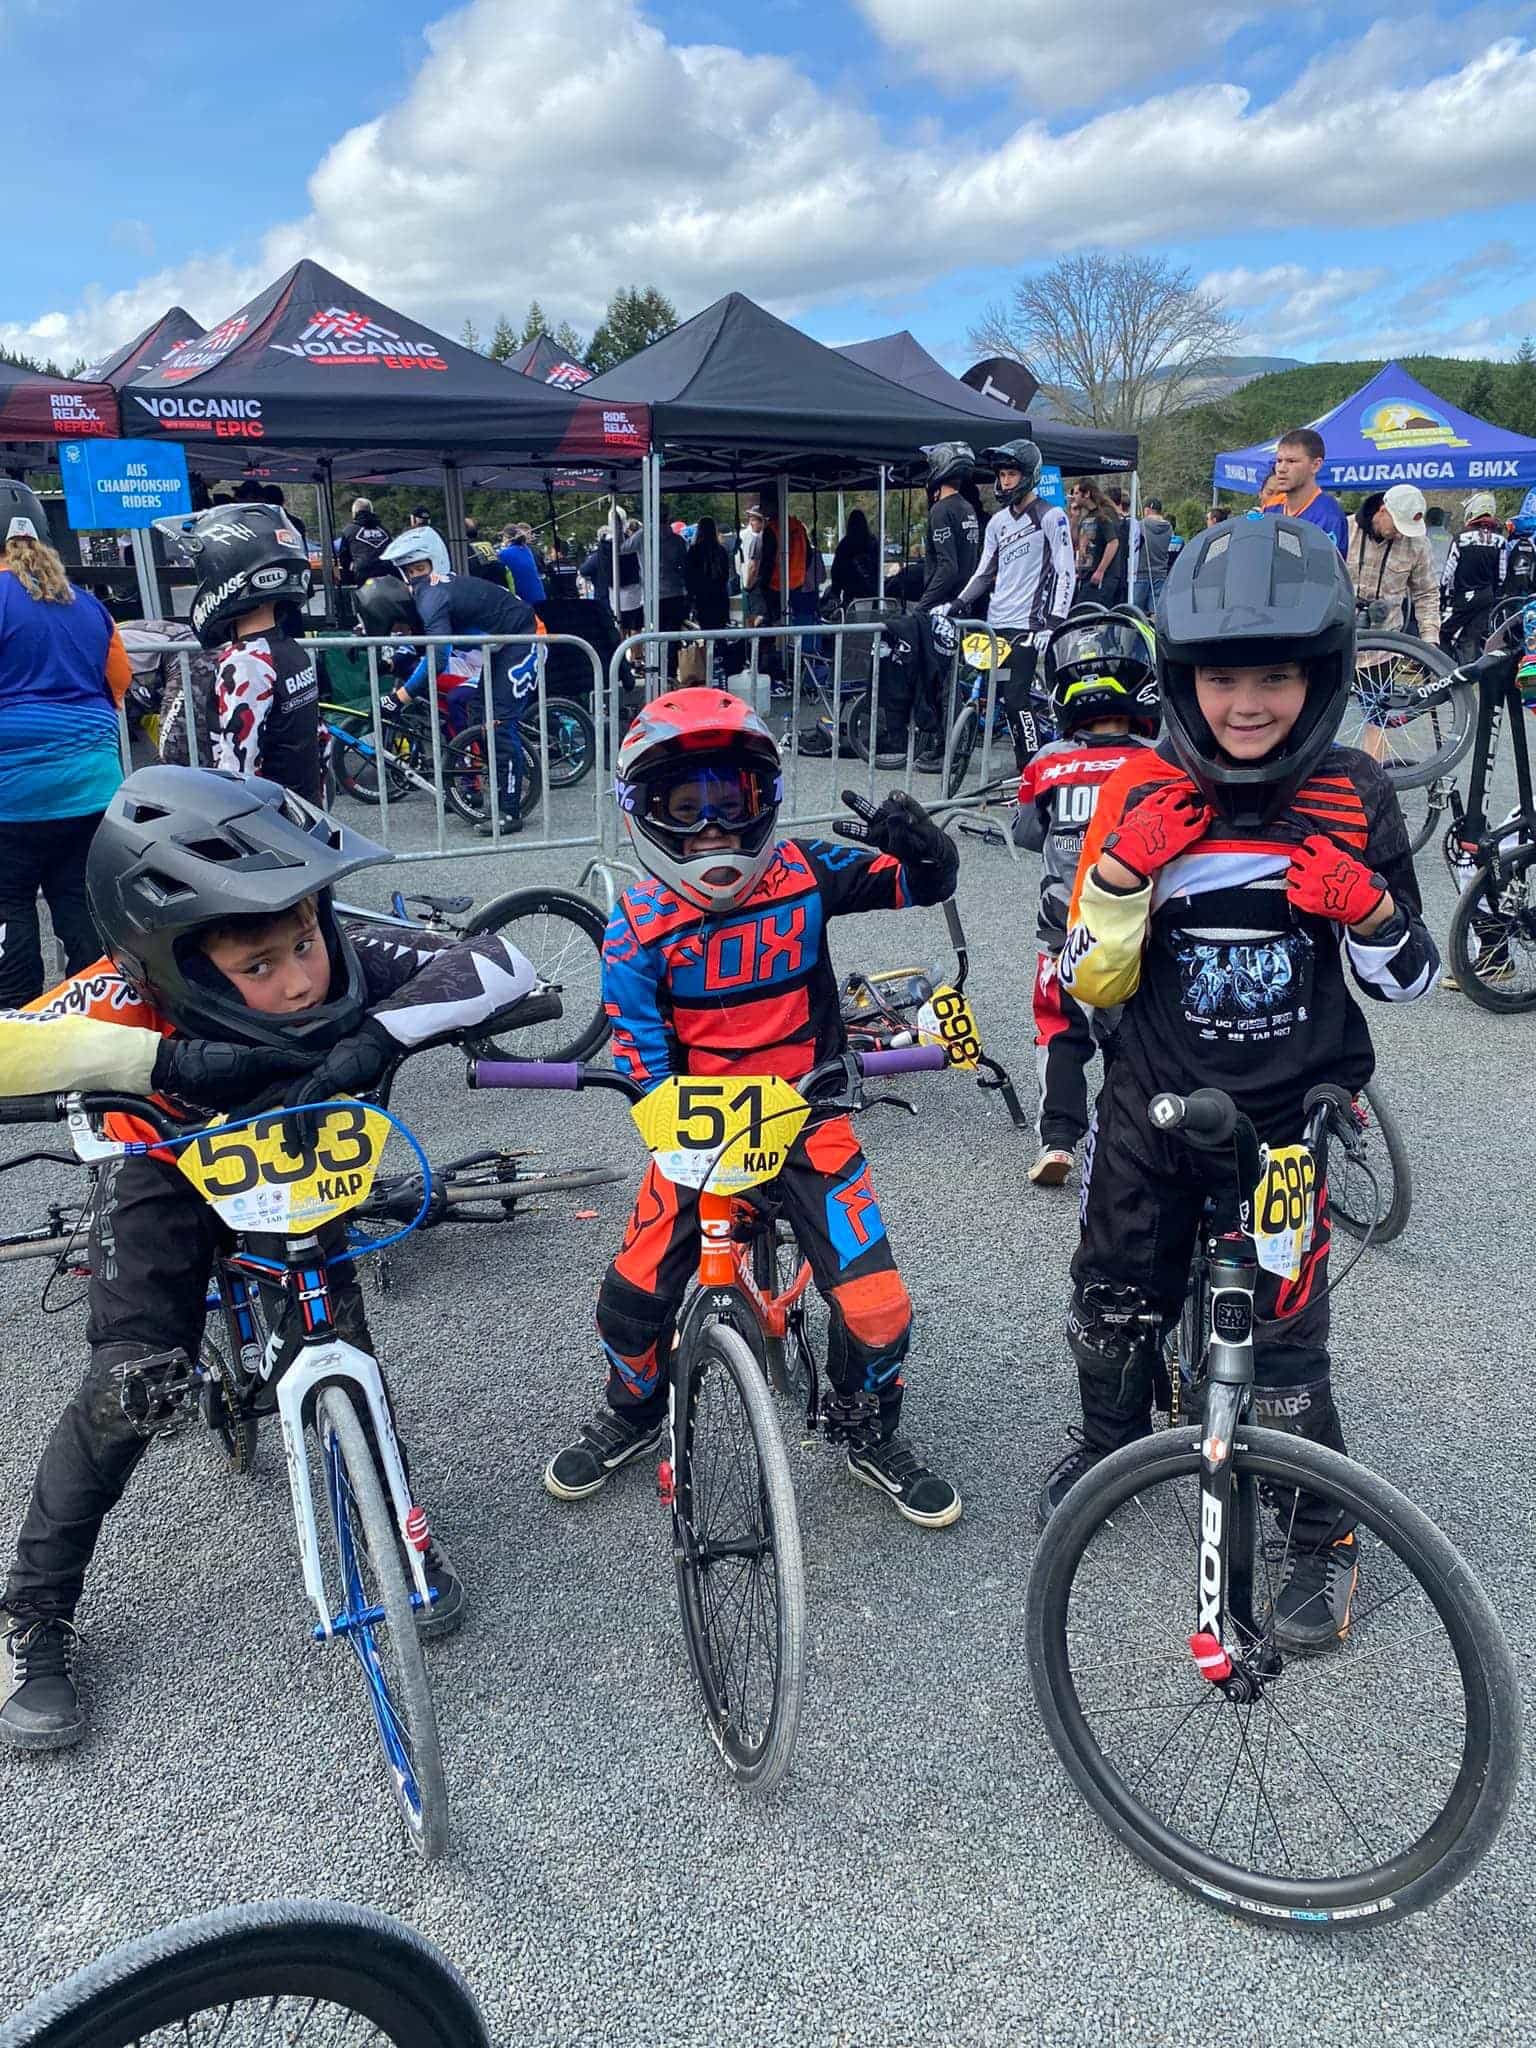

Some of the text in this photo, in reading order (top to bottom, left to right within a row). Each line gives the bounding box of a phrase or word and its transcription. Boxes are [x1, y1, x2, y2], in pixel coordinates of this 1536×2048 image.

[268, 341, 439, 357] VOLCANIC
[382, 356, 448, 371] EPIC
[50, 394, 86, 407] RIDE.
[134, 396, 262, 418] VOLCANIC
[52, 407, 101, 420] RELAX.
[215, 420, 265, 437] EPIC
[126, 463, 148, 477] AUS
[1330, 460, 1520, 483] TAURANGA BMX
[97, 479, 181, 493] CHAMPIONSHIP
[122, 495, 162, 509] RIDERS
[258, 572, 282, 584] BELL
[1041, 756, 1128, 781] alpinest
[662, 906, 806, 992] FOX
[932, 991, 980, 1064] 698
[676, 1085, 763, 1150] 51
[196, 1106, 373, 1197] 533
[743, 1151, 780, 1173] KAP
[316, 1173, 363, 1202] KAP
[299, 1285, 329, 1301] DK
[1199, 1487, 1223, 1646] BOX
